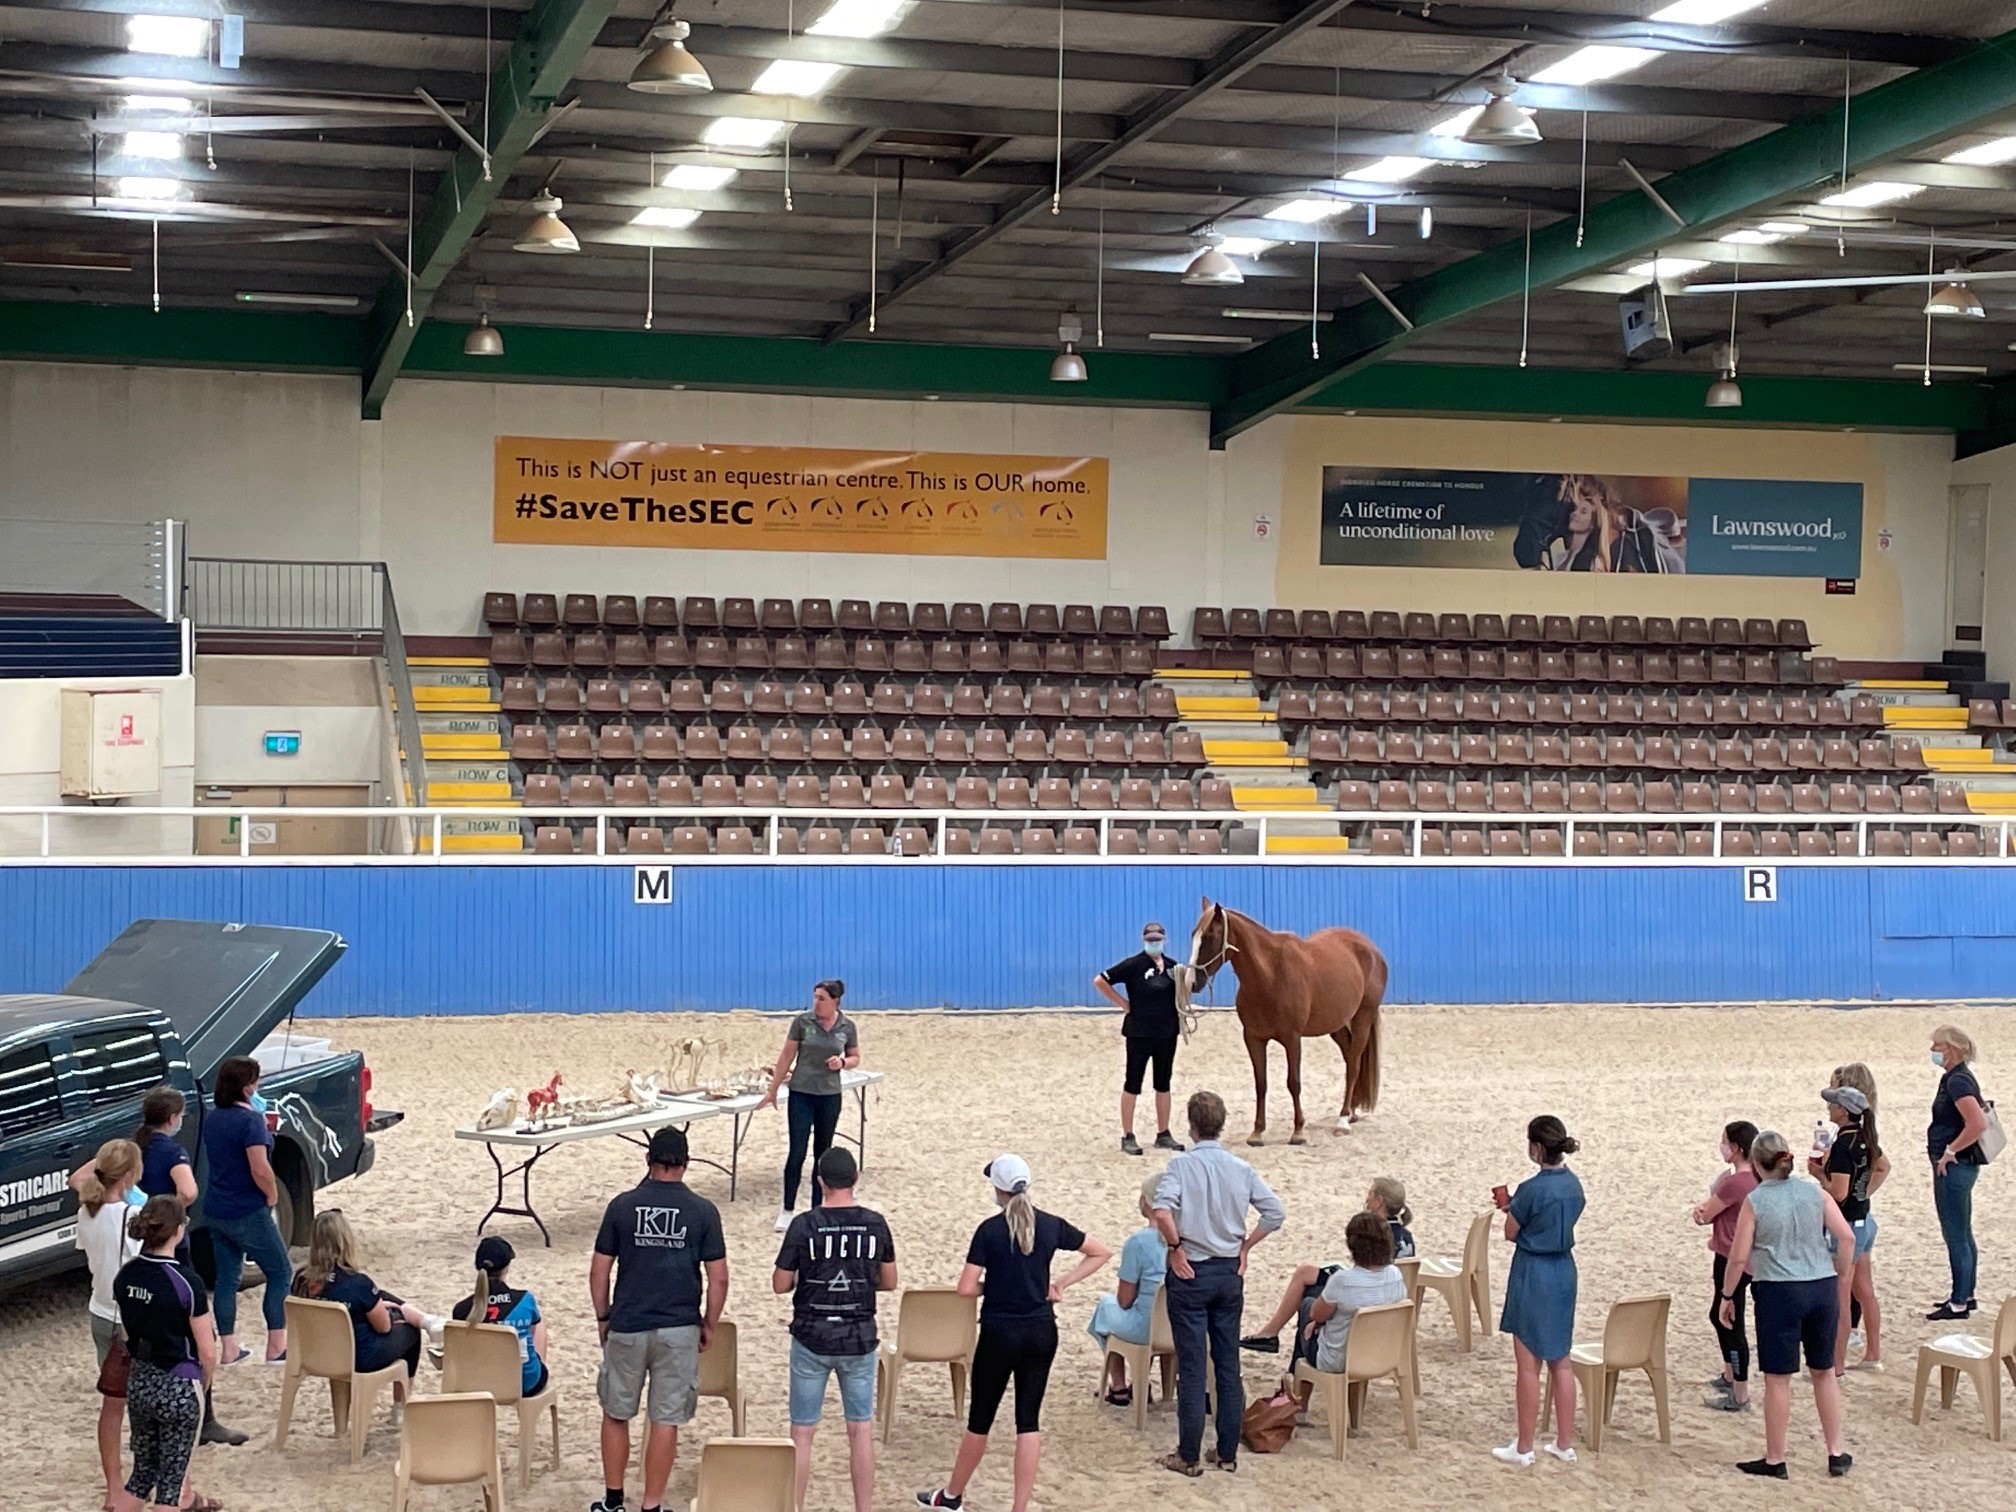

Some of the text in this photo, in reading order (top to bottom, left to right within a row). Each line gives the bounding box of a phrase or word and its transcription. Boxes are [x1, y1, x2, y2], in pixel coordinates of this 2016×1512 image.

[516, 457, 1091, 495] This is NOT just an equestrian centre. This is OUR home.
[516, 494, 754, 525] #SaveTheSEC
[1339, 502, 1445, 520] A lifetime of
[1340, 523, 1495, 542] unconditional love
[1712, 514, 1832, 538] Lawnswood
[441, 674, 486, 685] ROW E
[449, 721, 498, 732] ROW D
[458, 770, 506, 780] ROW C
[467, 821, 499, 832] ROW
[638, 870, 669, 899] M
[1749, 869, 1771, 898] R
[0, 1169, 70, 1207] STRICARE
[634, 1206, 687, 1239] KL
[634, 1238, 686, 1249] KINGSLAND
[809, 1234, 876, 1260] LUCID
[126, 1285, 153, 1304] Tilly
